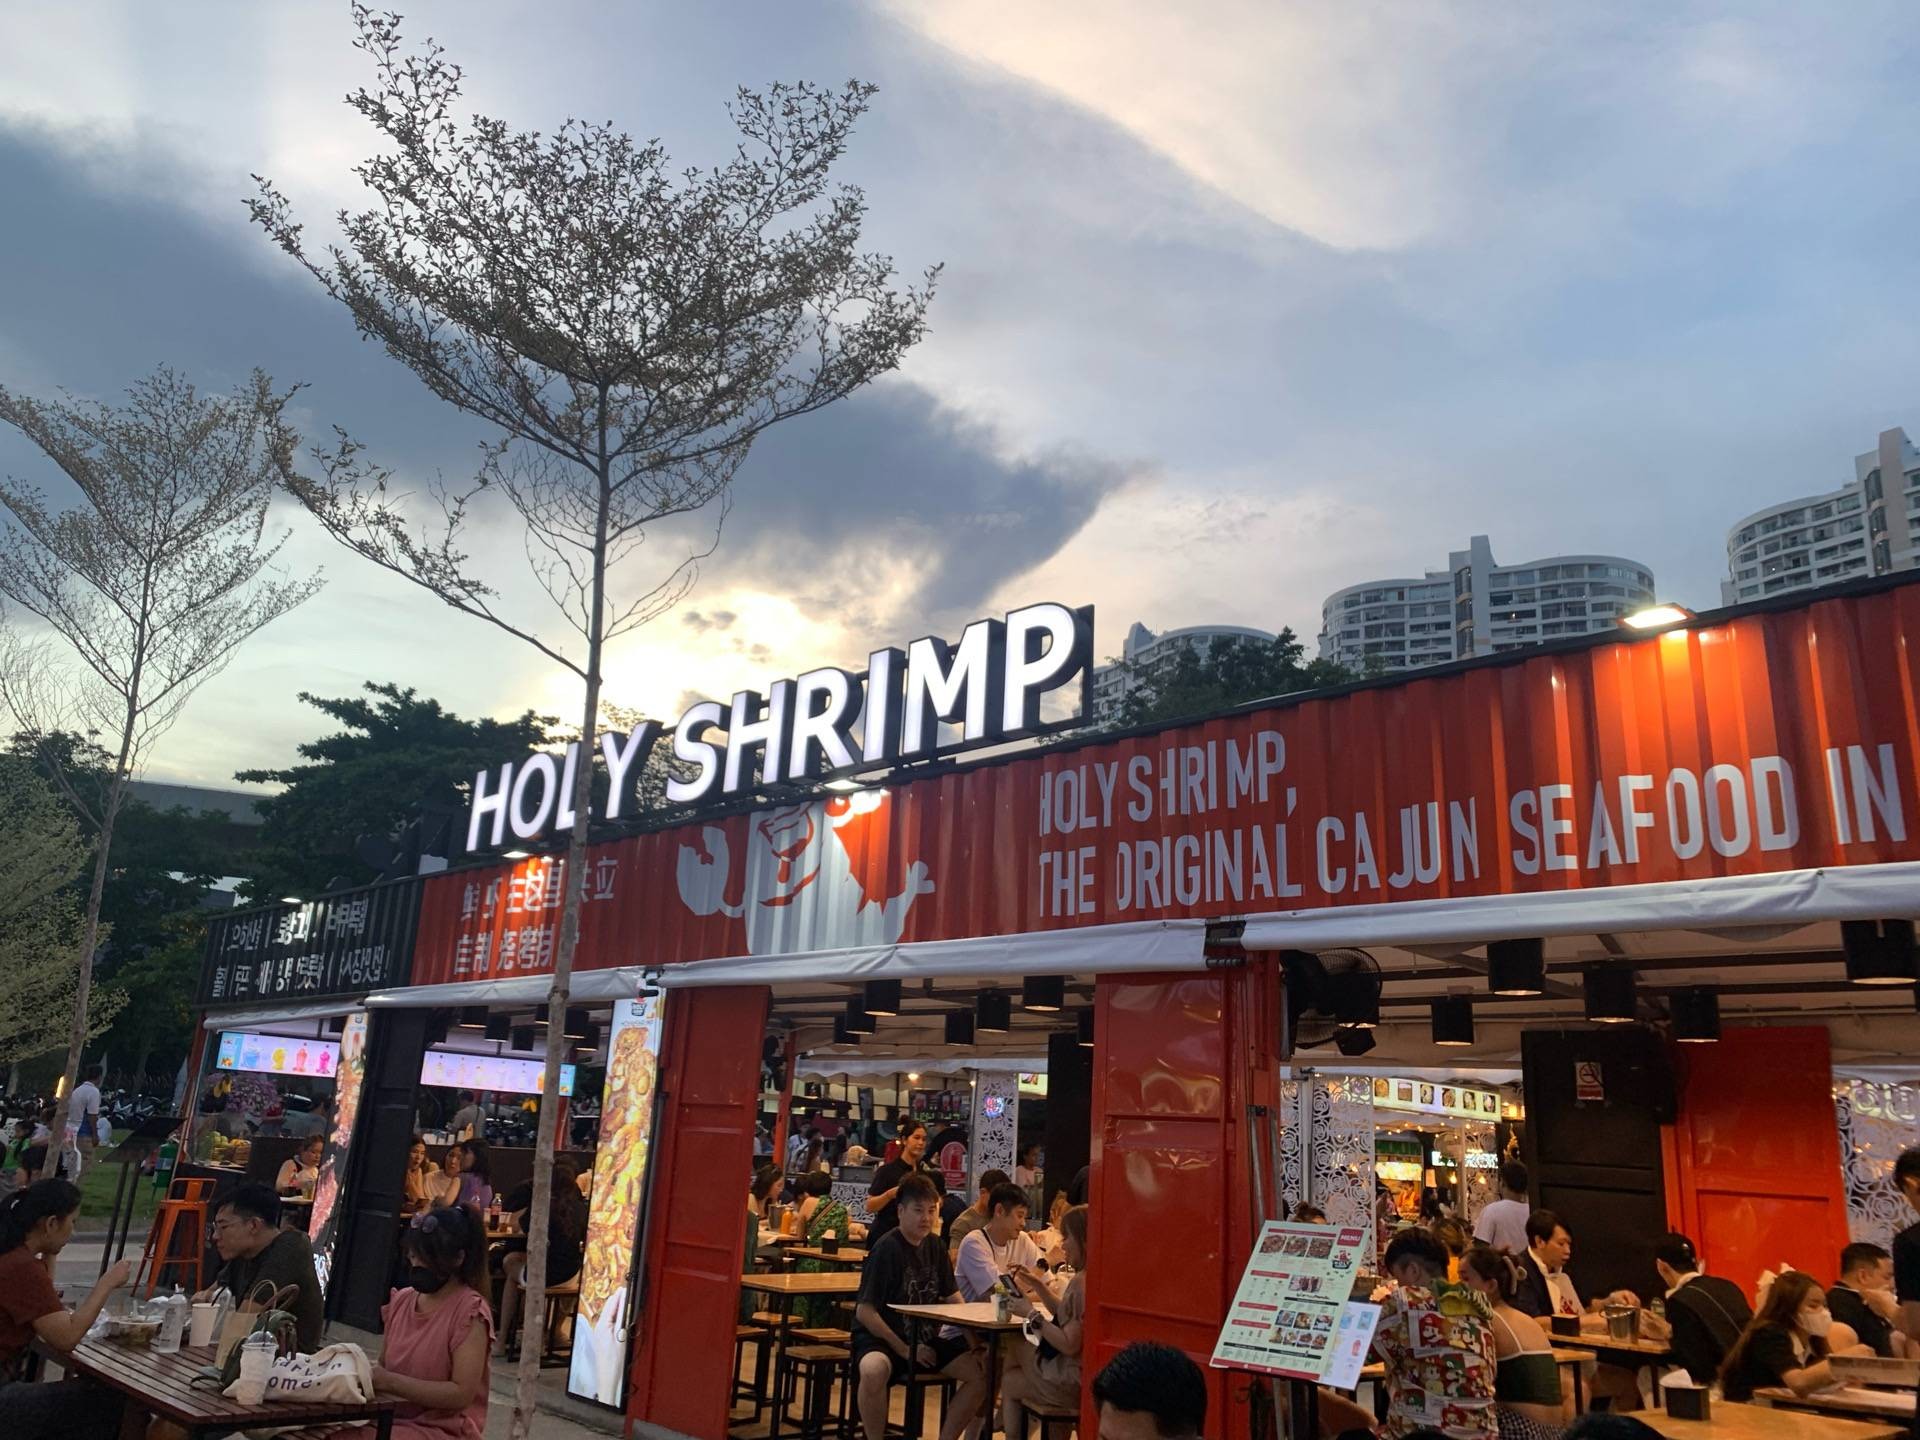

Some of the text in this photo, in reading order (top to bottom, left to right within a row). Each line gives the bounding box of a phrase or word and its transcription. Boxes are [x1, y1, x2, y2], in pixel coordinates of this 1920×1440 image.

[467, 602, 1083, 851] HOLY SHRIMP
[1039, 730, 1297, 837] HOLY SHRIMP,
[1039, 744, 1907, 918] THE ORIGINAL CAJUN SEAFOOD IN
